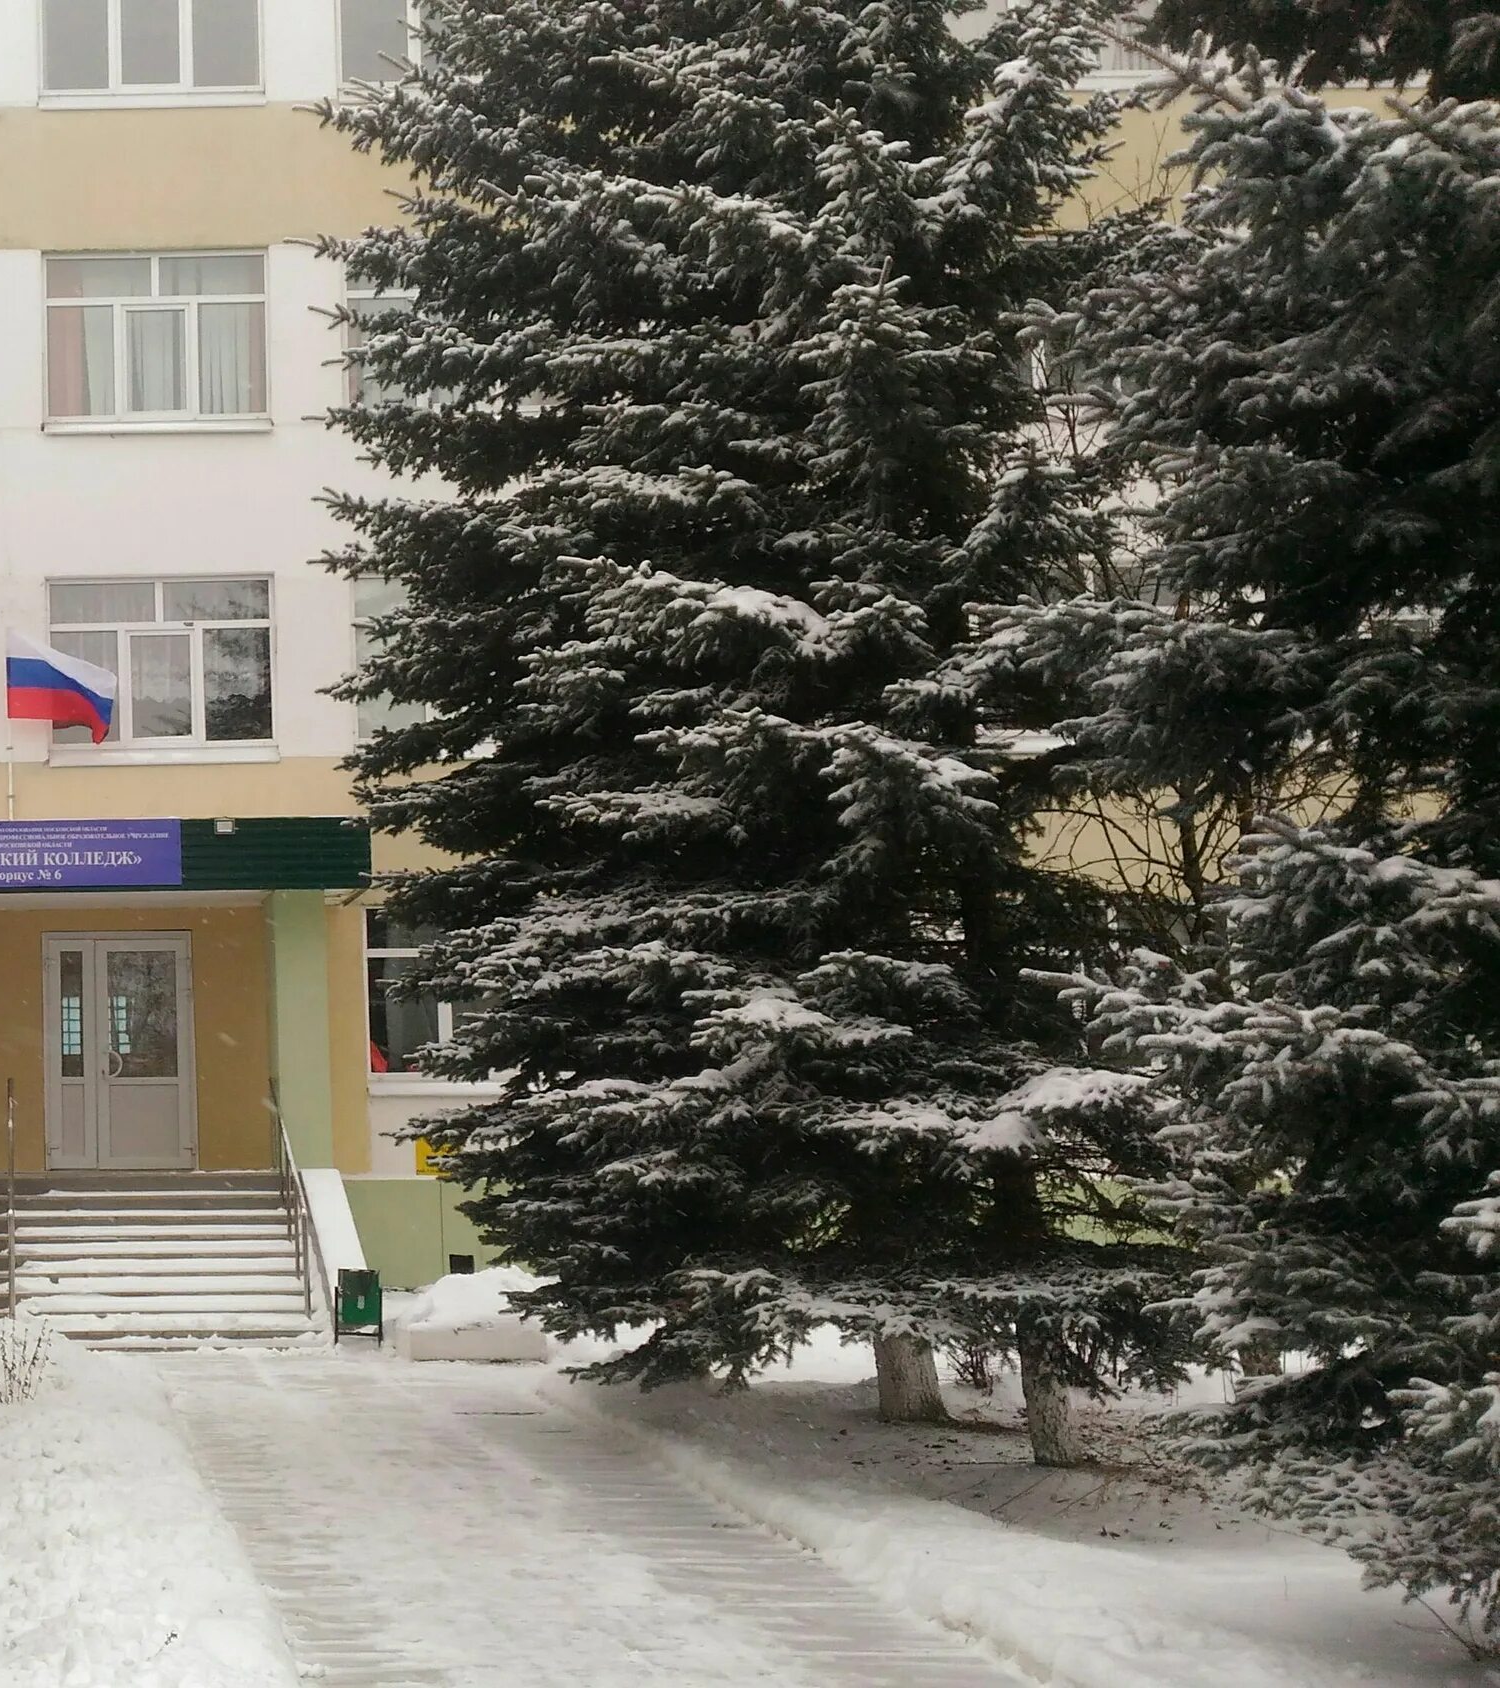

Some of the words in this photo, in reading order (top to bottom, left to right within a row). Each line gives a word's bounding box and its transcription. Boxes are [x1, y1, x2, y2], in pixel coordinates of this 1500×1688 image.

[43, 851, 142, 867] КОЛЛЕДЖ»
[37, 869, 52, 880] №
[54, 869, 62, 880] 6
